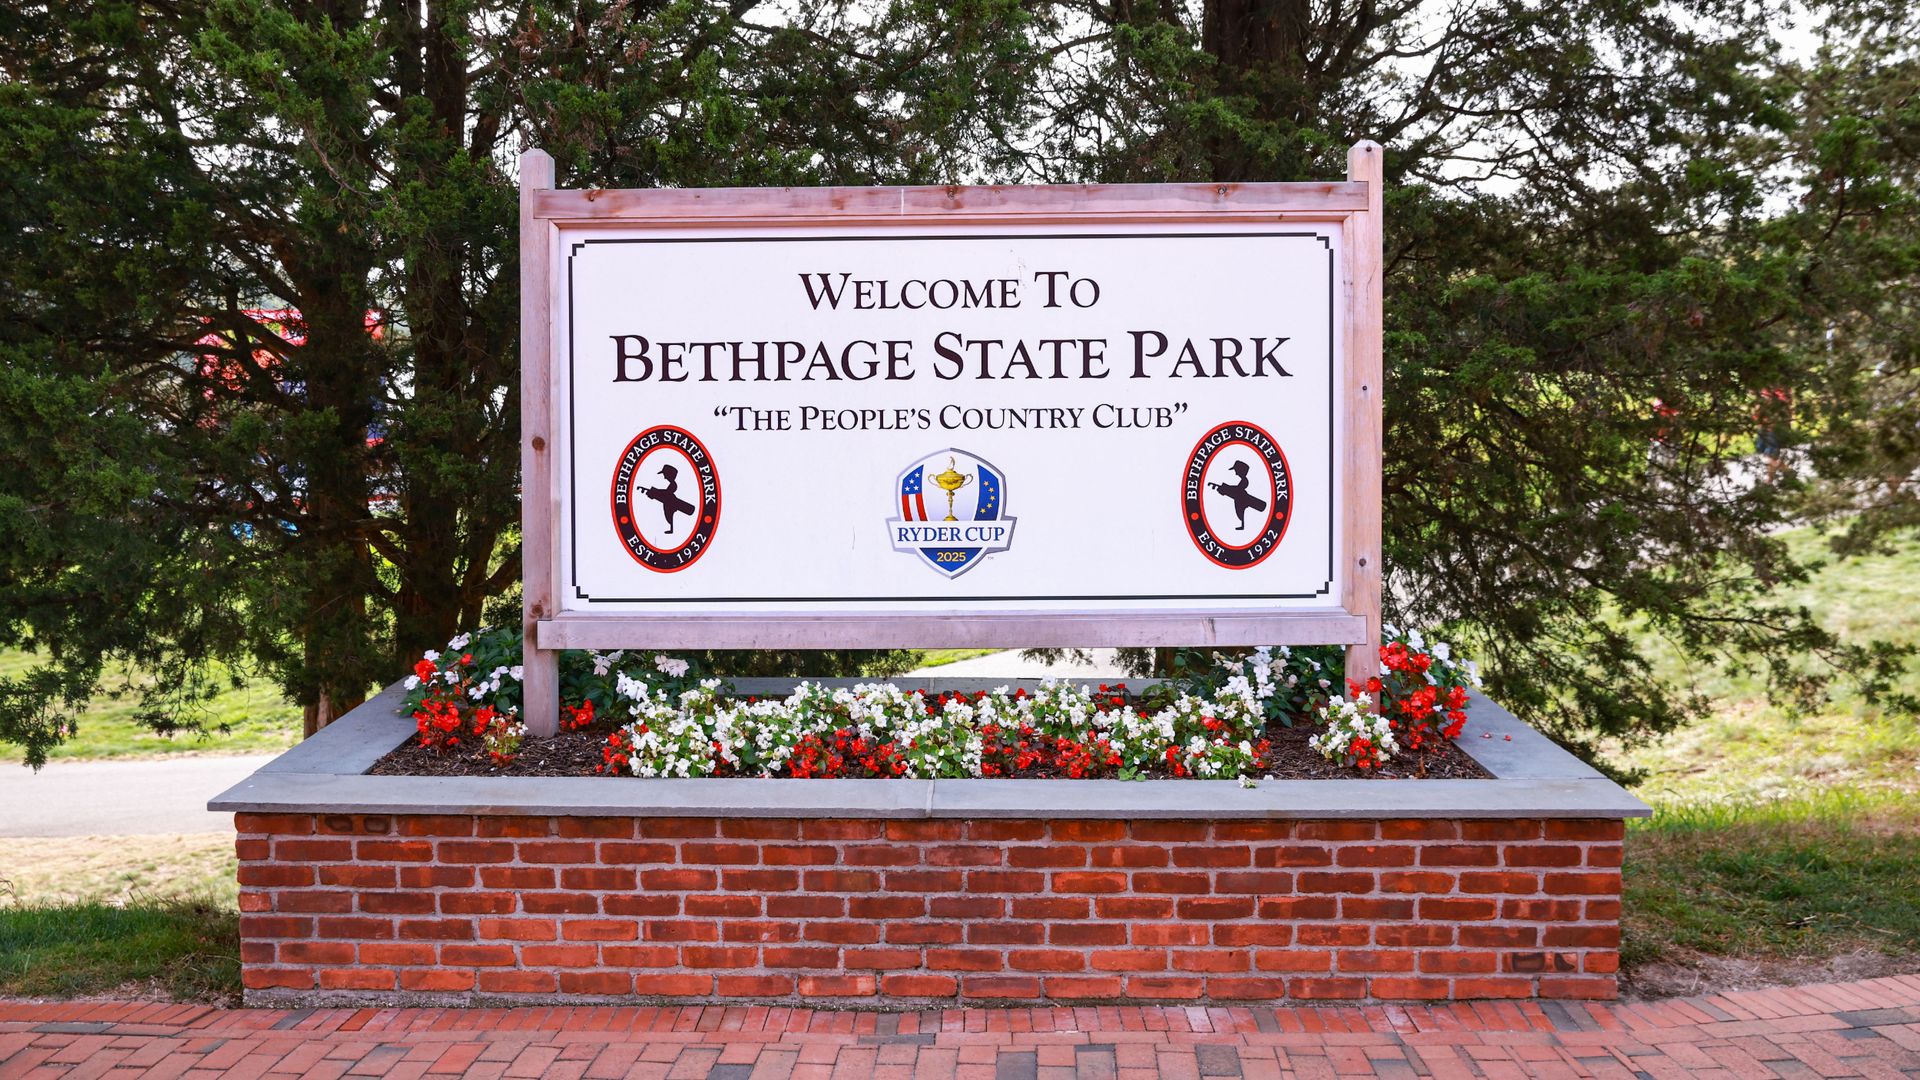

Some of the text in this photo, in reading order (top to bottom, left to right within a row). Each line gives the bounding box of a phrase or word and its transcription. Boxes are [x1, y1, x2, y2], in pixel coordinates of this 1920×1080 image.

[798, 271, 1100, 311] WELCOME TO
[609, 330, 1294, 383] BETHPAGE STATE PARK
[939, 404, 1085, 430] COUNTRY
[616, 430, 716, 505] BETHPAGE STATE PARK
[1187, 426, 1288, 501] BETHPAGE STATE PARK
[627, 533, 707, 565] EST. 1932
[897, 526, 1005, 542] RYDER CUP
[1197, 529, 1278, 562] EST. 1932
[936, 551, 967, 562] 2025
